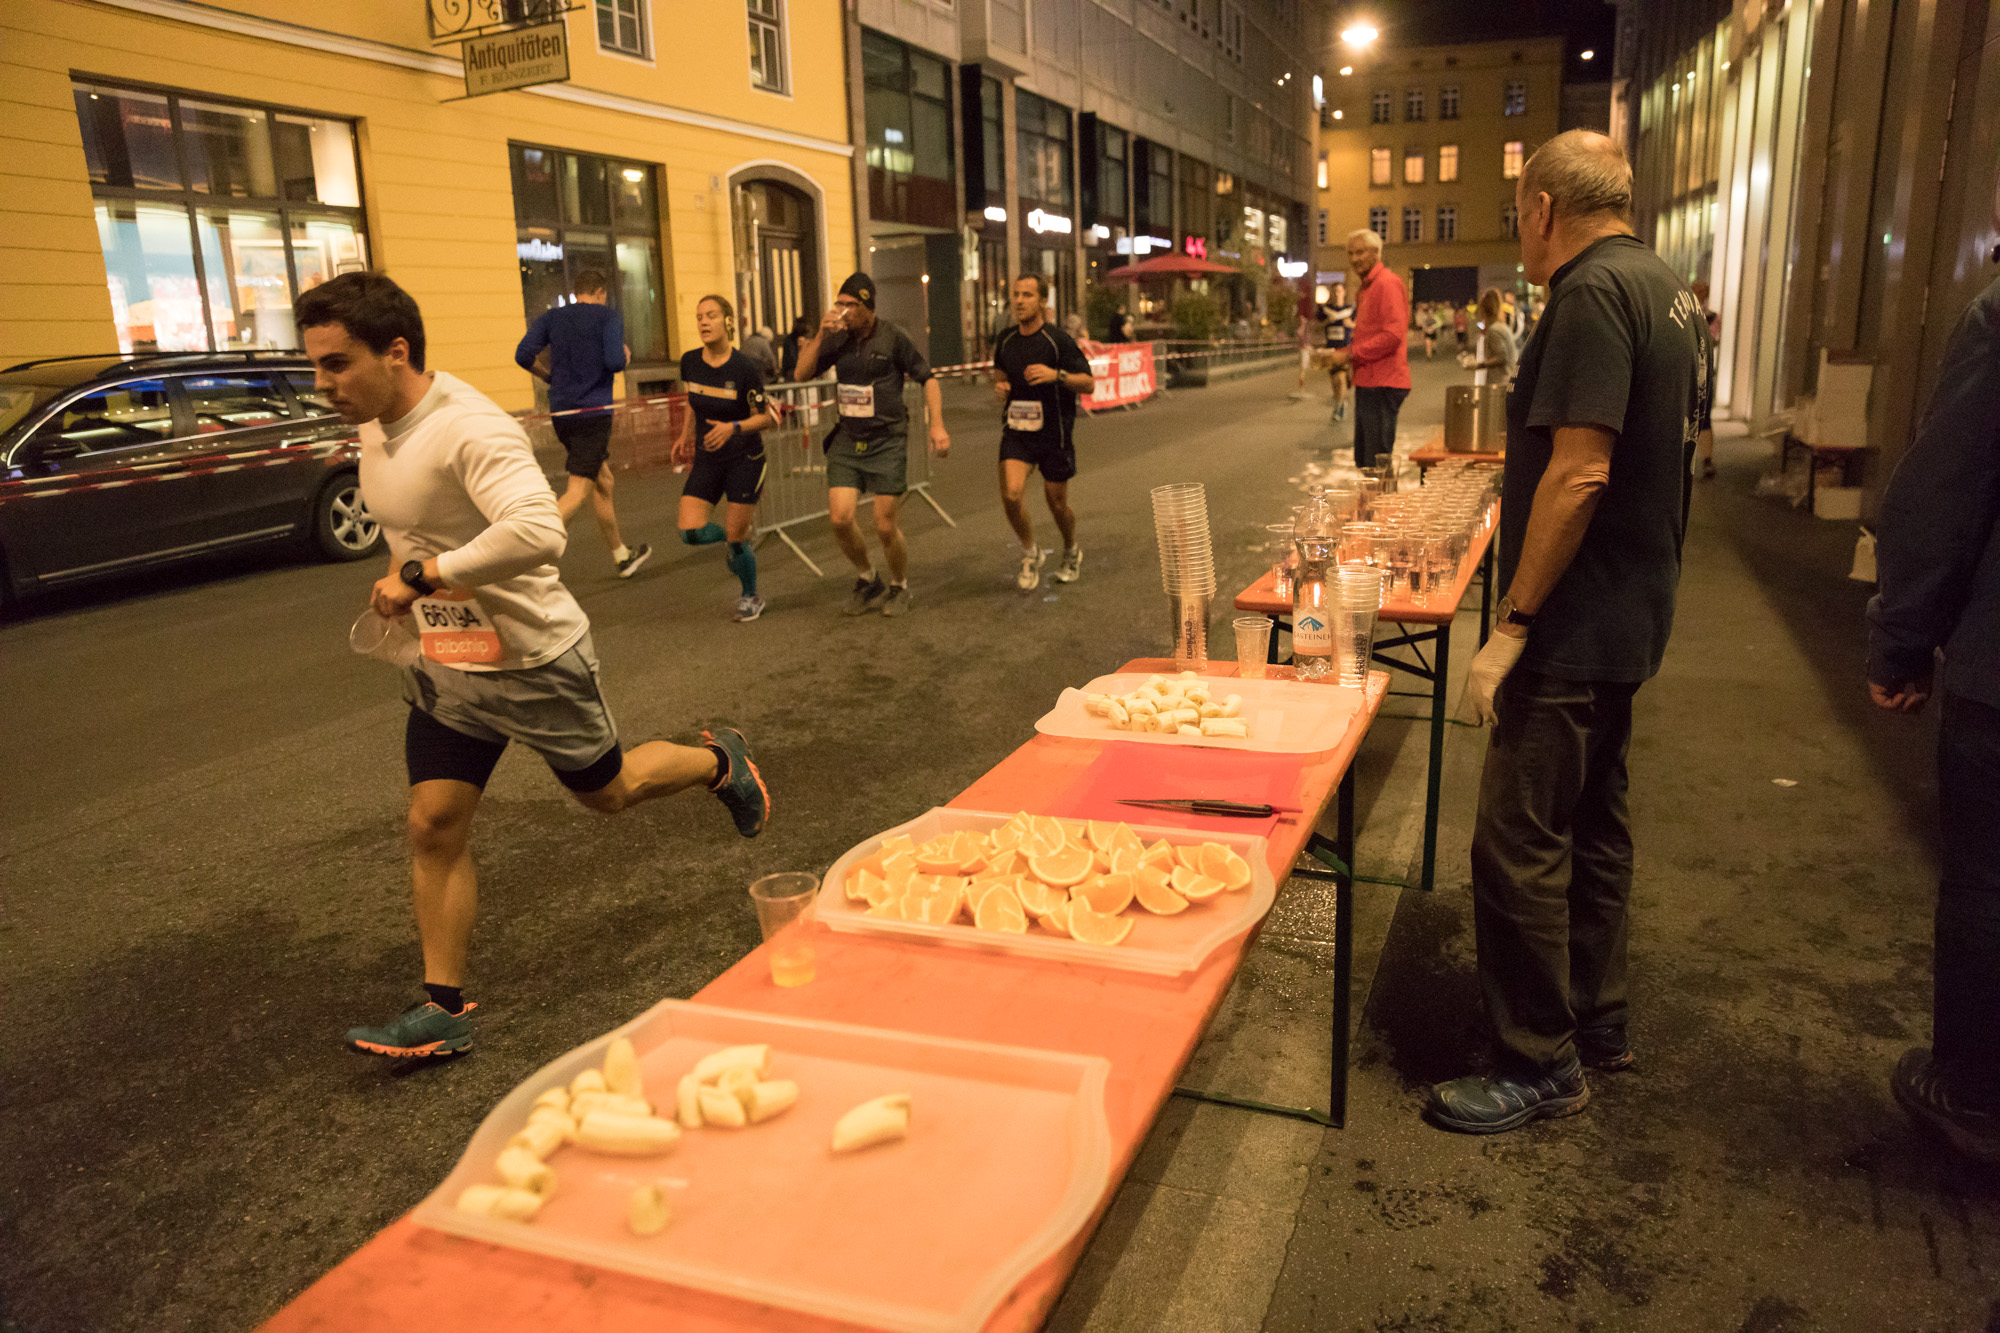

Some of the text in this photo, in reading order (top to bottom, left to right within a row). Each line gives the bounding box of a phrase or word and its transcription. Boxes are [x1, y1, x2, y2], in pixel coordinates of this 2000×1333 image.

[469, 35, 561, 71] Antiquitäten
[421, 604, 481, 628] 66194
[1294, 632, 1332, 641] ASTEINE
